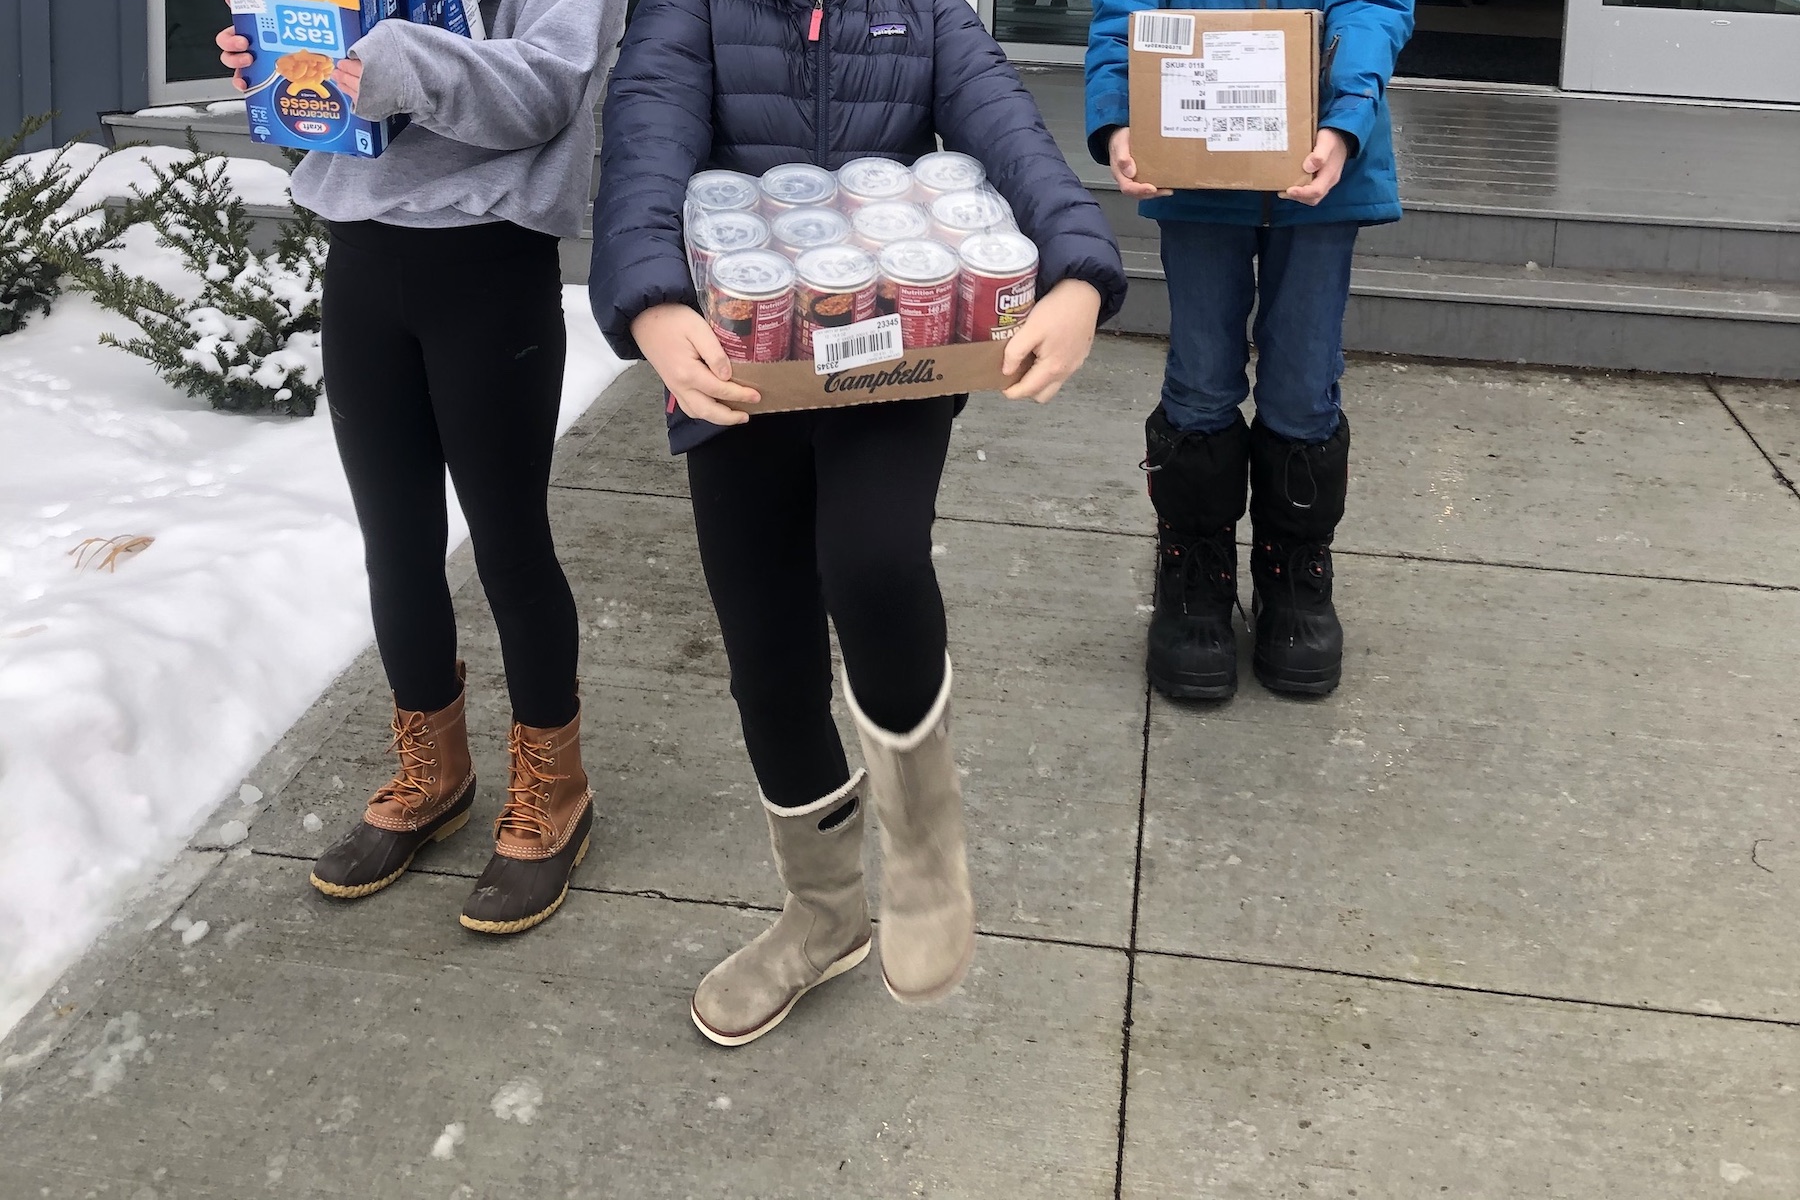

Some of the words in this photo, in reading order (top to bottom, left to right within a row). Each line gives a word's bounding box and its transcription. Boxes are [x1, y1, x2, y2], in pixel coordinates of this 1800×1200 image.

[251, 109, 267, 119] 3.5
[282, 108, 288, 116] &
[290, 109, 340, 120] macaroni
[302, 123, 322, 131] Kraft
[360, 138, 368, 150] 6
[902, 288, 934, 296] Nutrition
[877, 318, 899, 329] 23345
[817, 361, 839, 372] 23345
